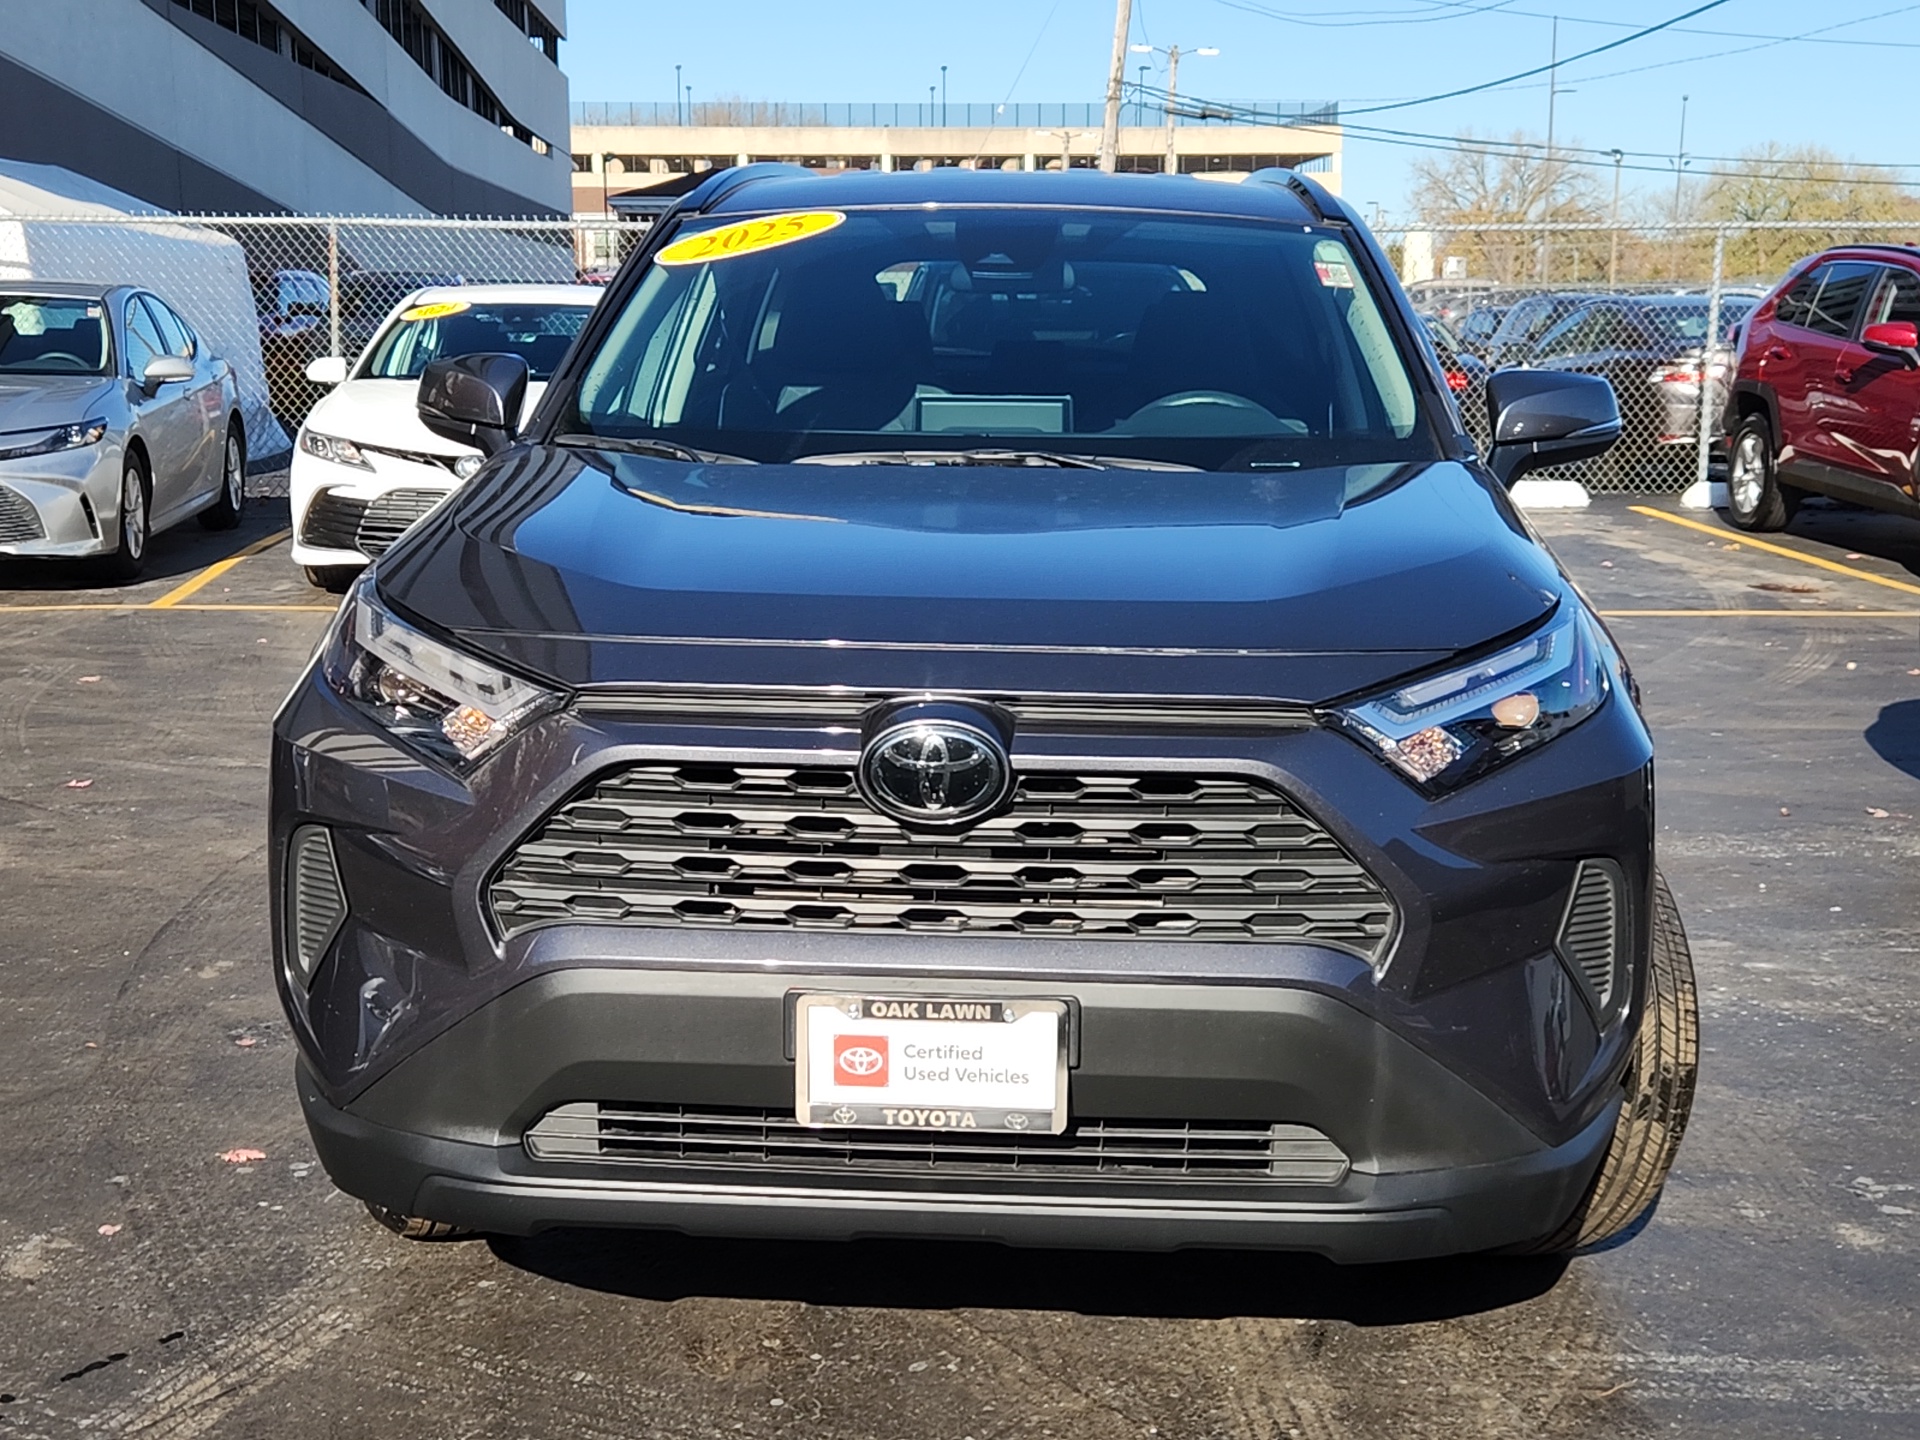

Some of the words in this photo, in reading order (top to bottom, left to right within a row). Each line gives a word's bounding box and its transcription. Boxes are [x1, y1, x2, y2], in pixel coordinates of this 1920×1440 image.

[692, 215, 808, 259] 2025
[871, 1002, 919, 1019] OAK
[926, 1003, 991, 1021] LAWN
[904, 1044, 983, 1061] Certified
[904, 1067, 950, 1082] Used
[955, 1068, 1030, 1085] Vehicles
[883, 1109, 977, 1128] TOYOTA
